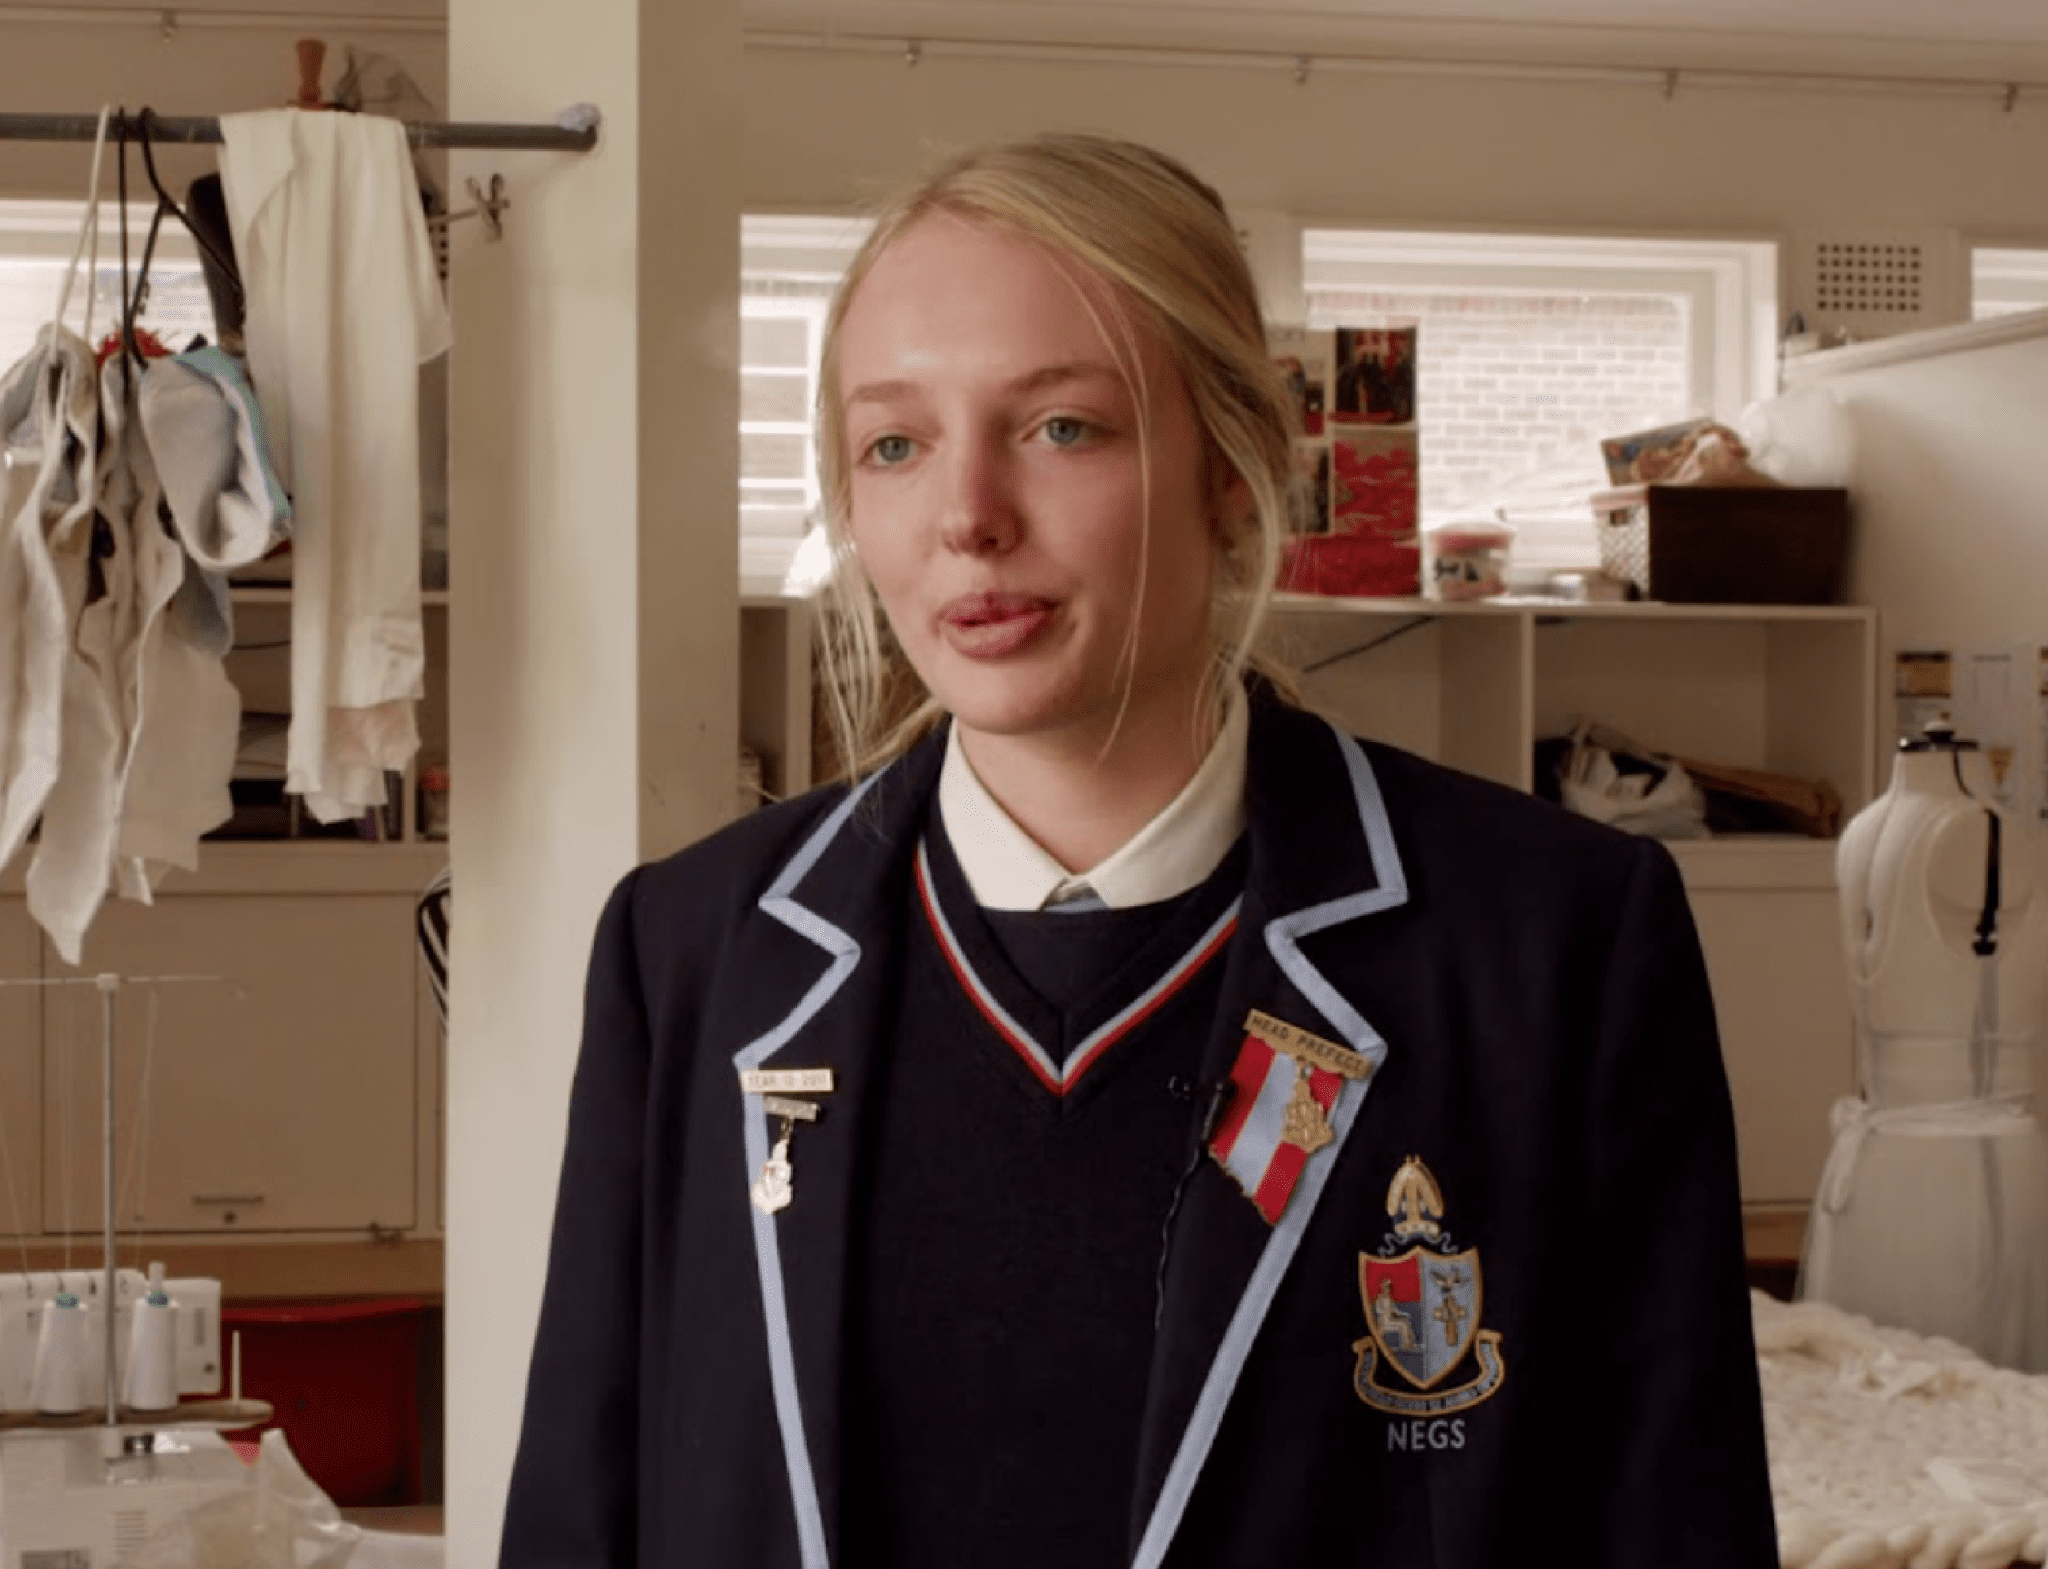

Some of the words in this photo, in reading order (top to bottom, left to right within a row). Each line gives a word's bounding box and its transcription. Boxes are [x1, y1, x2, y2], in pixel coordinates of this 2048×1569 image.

[1251, 1015, 1290, 1041] HEAD
[1296, 1034, 1364, 1074] PREFECT
[1387, 1418, 1466, 1452] NEGS
